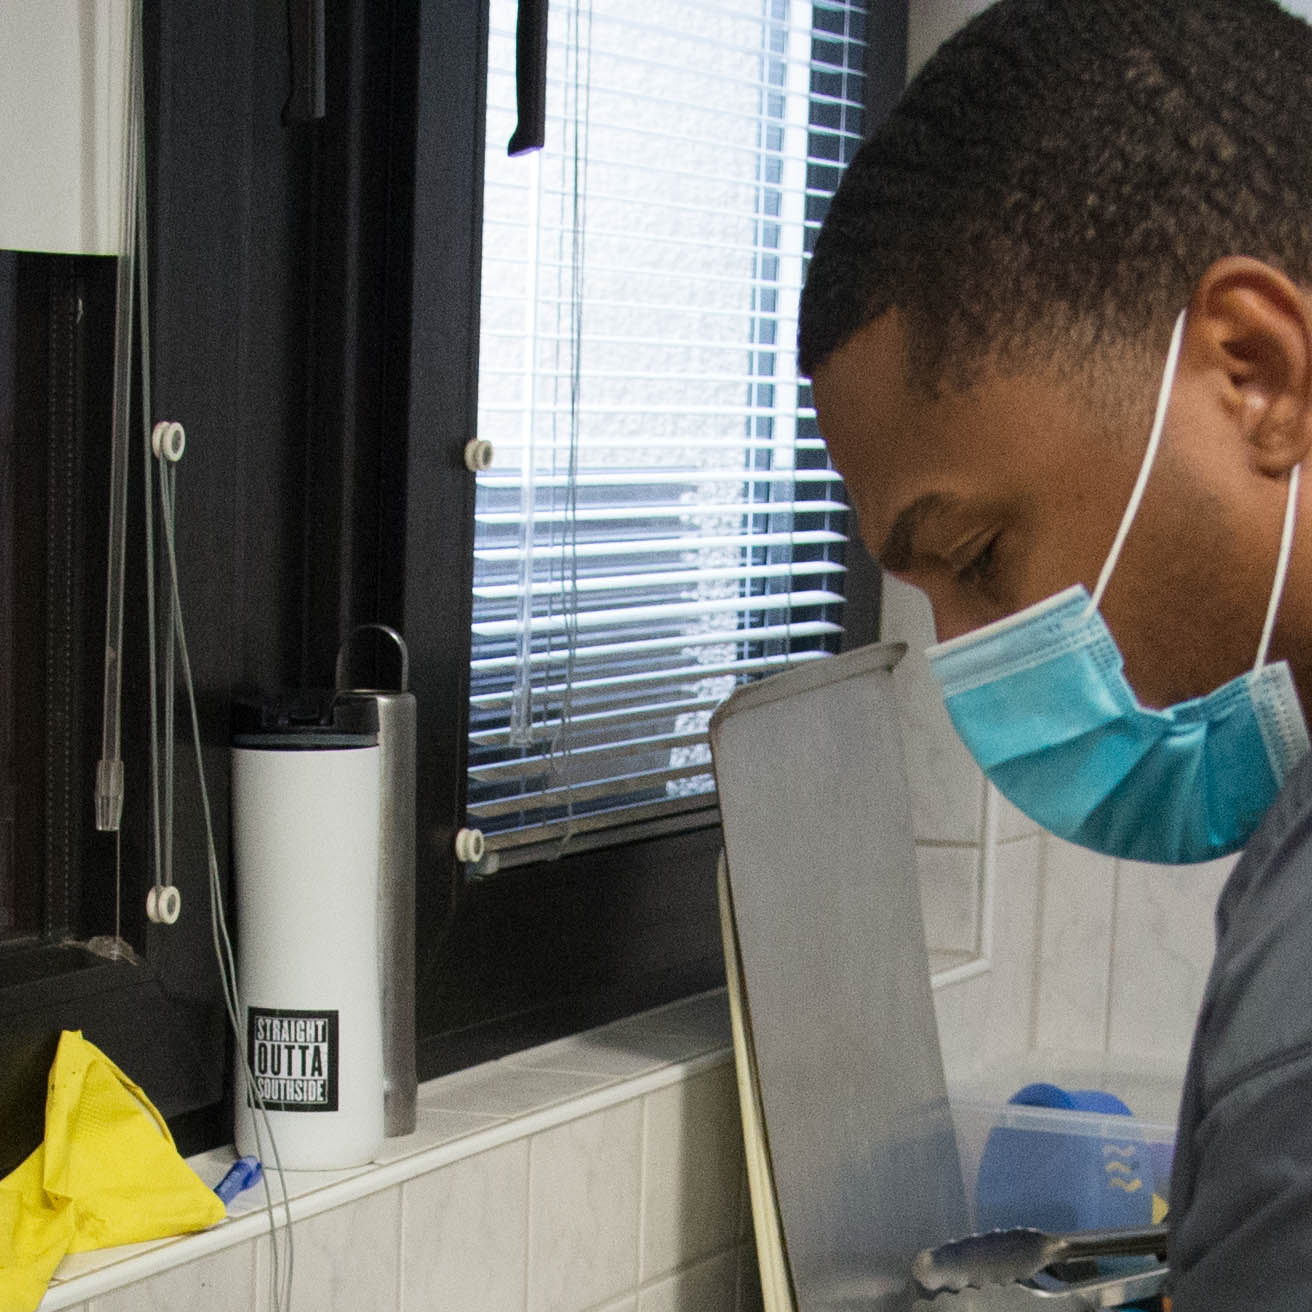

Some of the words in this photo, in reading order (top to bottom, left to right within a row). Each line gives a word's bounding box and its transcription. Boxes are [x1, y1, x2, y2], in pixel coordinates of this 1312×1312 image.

[257, 1019, 324, 1042] STRAIGHT
[257, 1043, 323, 1077] OUTTA
[257, 1078, 324, 1101] SOUTHSIDE
